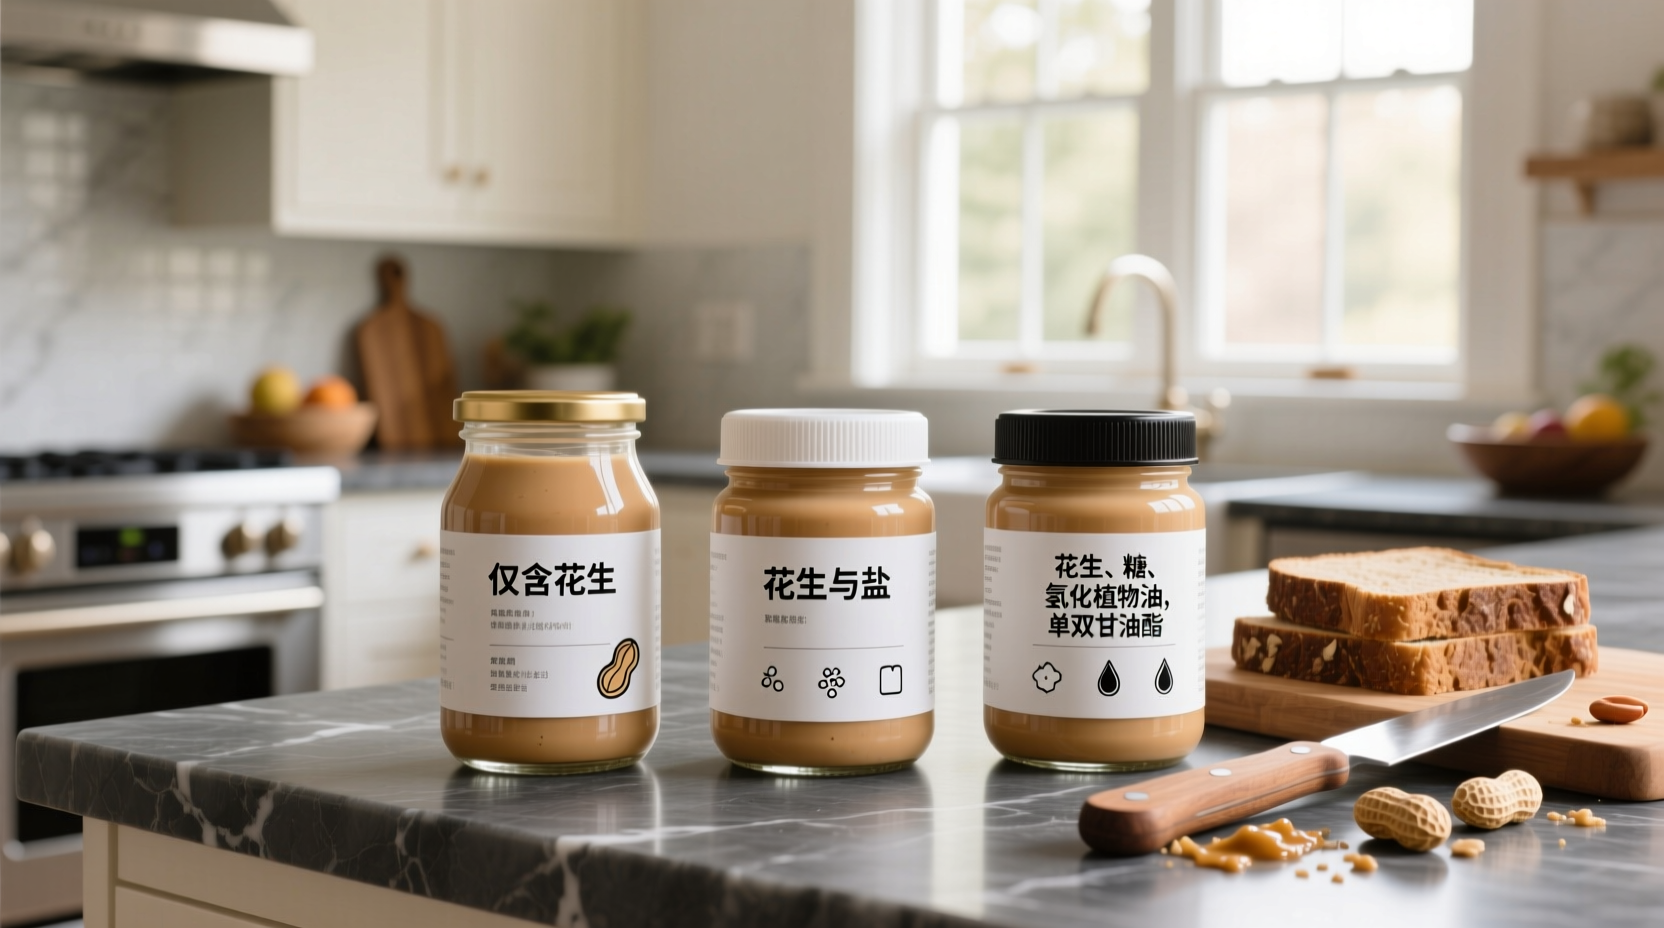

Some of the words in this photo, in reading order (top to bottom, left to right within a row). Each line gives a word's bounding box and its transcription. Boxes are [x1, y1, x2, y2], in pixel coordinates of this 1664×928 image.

[488, 562, 617, 597] 仅含花生
[763, 566, 891, 601] 花生与盐
[1048, 612, 1164, 639] 单双甘油酯
